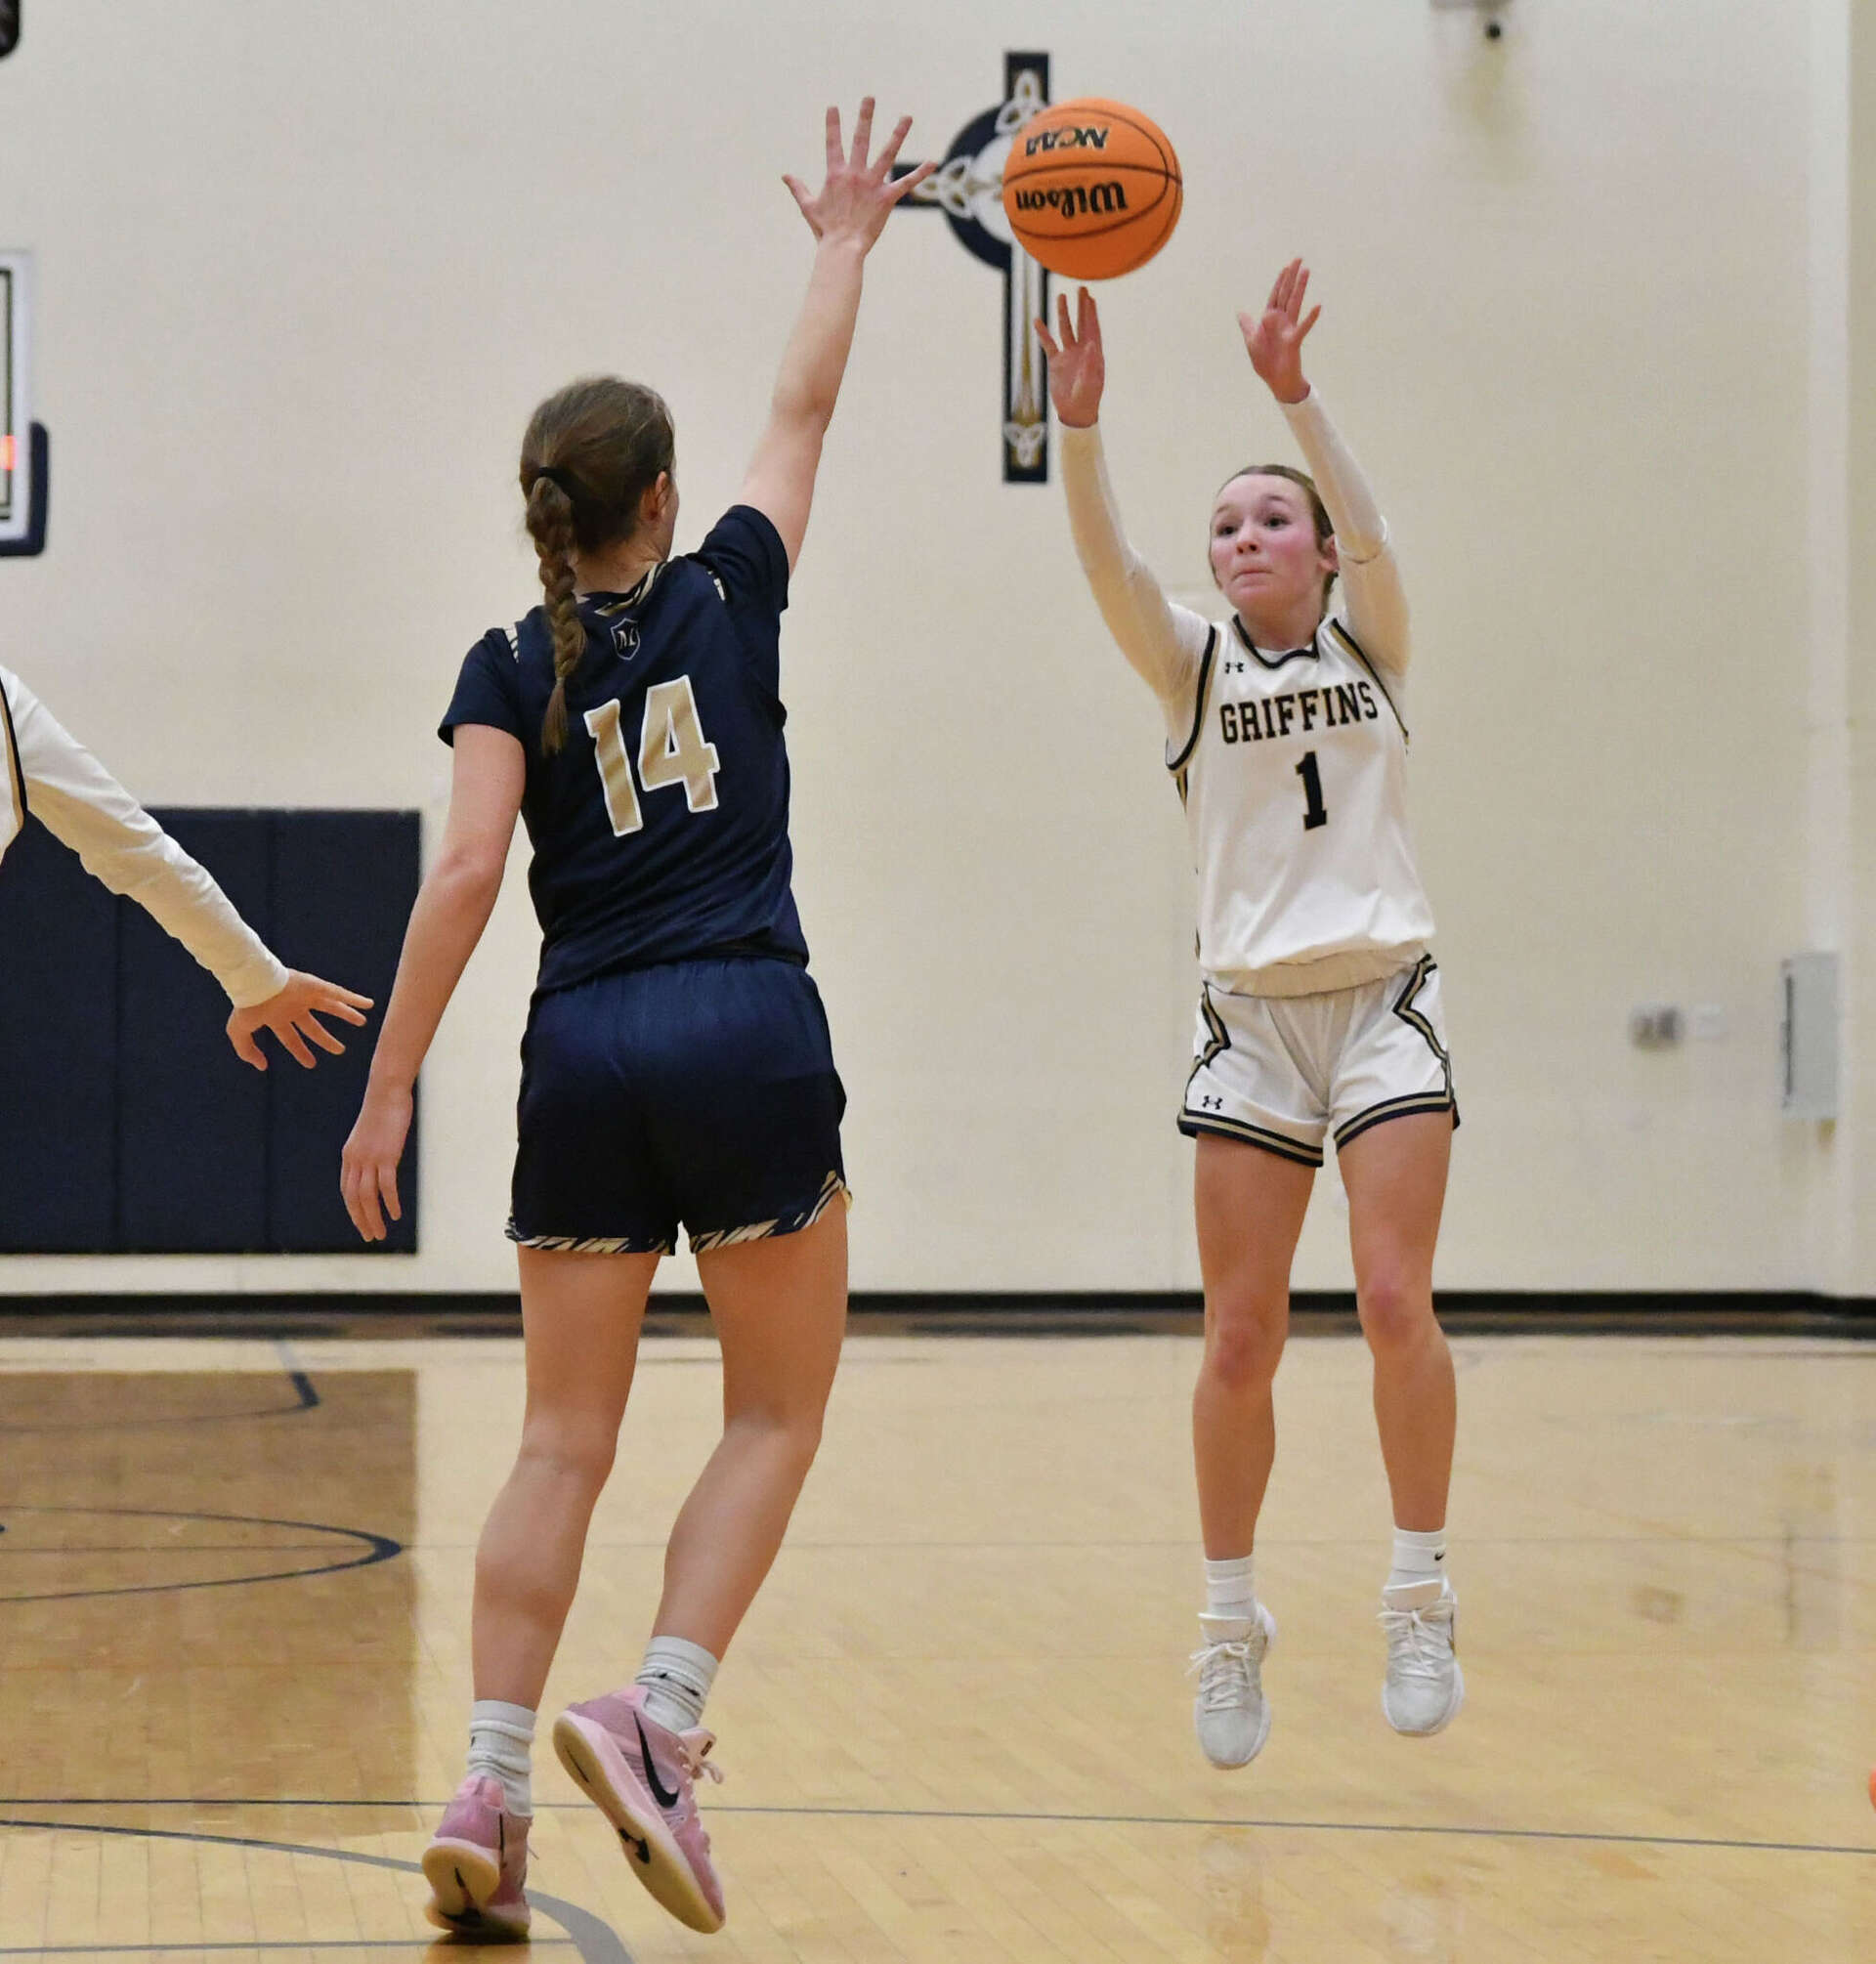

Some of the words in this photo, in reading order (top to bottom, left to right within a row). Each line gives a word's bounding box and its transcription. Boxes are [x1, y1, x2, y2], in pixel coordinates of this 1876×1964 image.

[1016, 182, 1127, 218] Wilson
[1220, 682, 1378, 744] GRIFFINS
[583, 674, 720, 836] 14
[1296, 751, 1327, 831] 1
